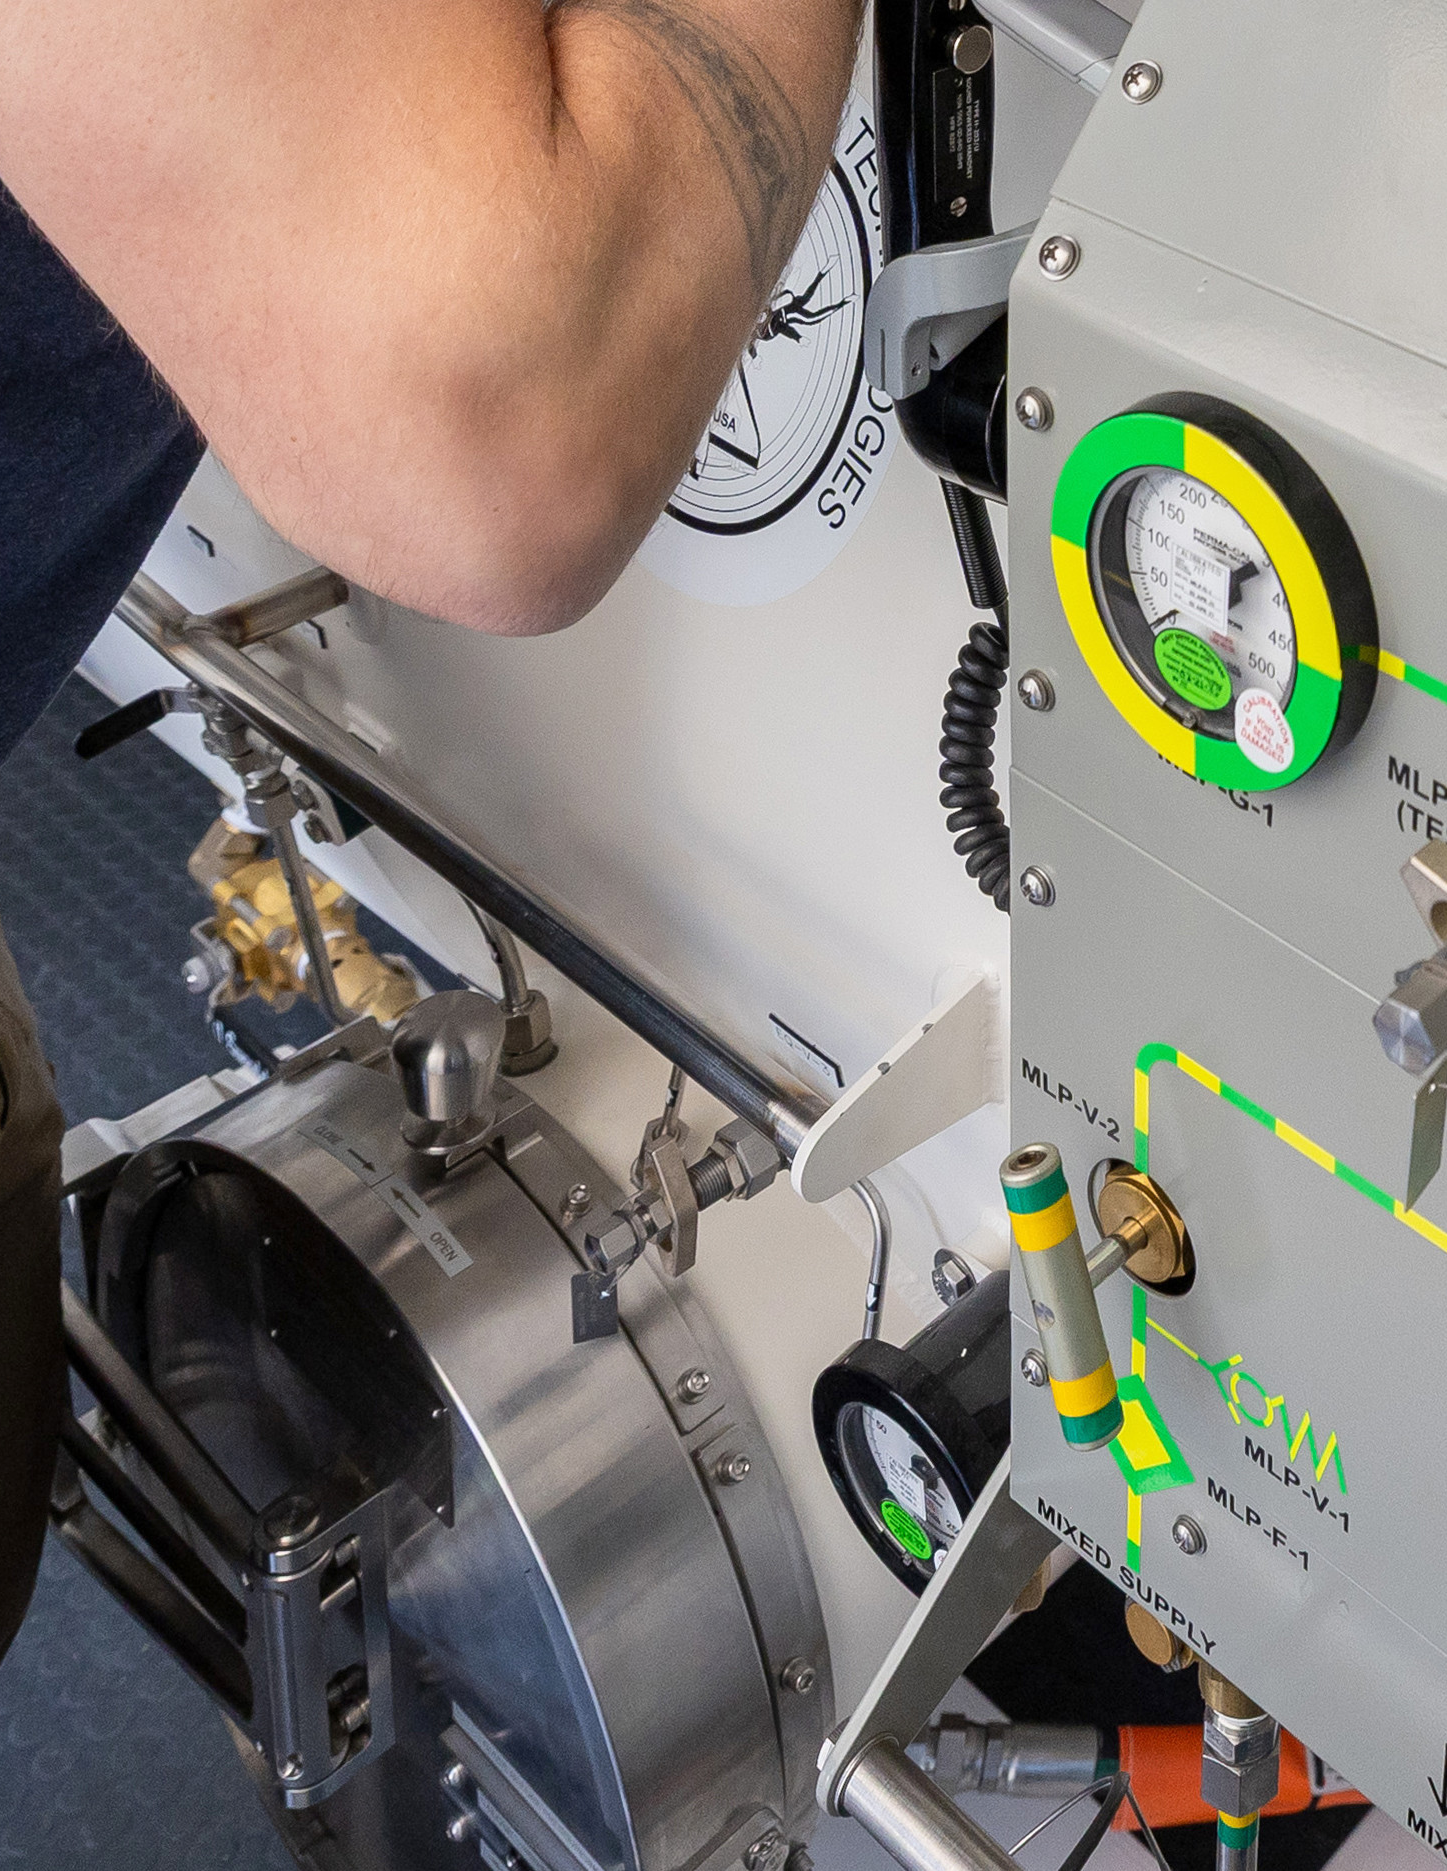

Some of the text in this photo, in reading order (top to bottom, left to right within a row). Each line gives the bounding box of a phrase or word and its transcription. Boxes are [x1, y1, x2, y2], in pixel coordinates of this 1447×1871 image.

[713, 410, 737, 433] USA
[1178, 482, 1207, 510] 200
[1158, 499, 1186, 526] 150
[1150, 565, 1169, 590] 50
[1248, 652, 1276, 679] 500
[1021, 1058, 1121, 1143] MLP-V-2
[1244, 1435, 1350, 1534] MLP-V-1
[1206, 1476, 1310, 1572] MLP-F-1
[1037, 1495, 1217, 1657] MIXED SUPPLY
